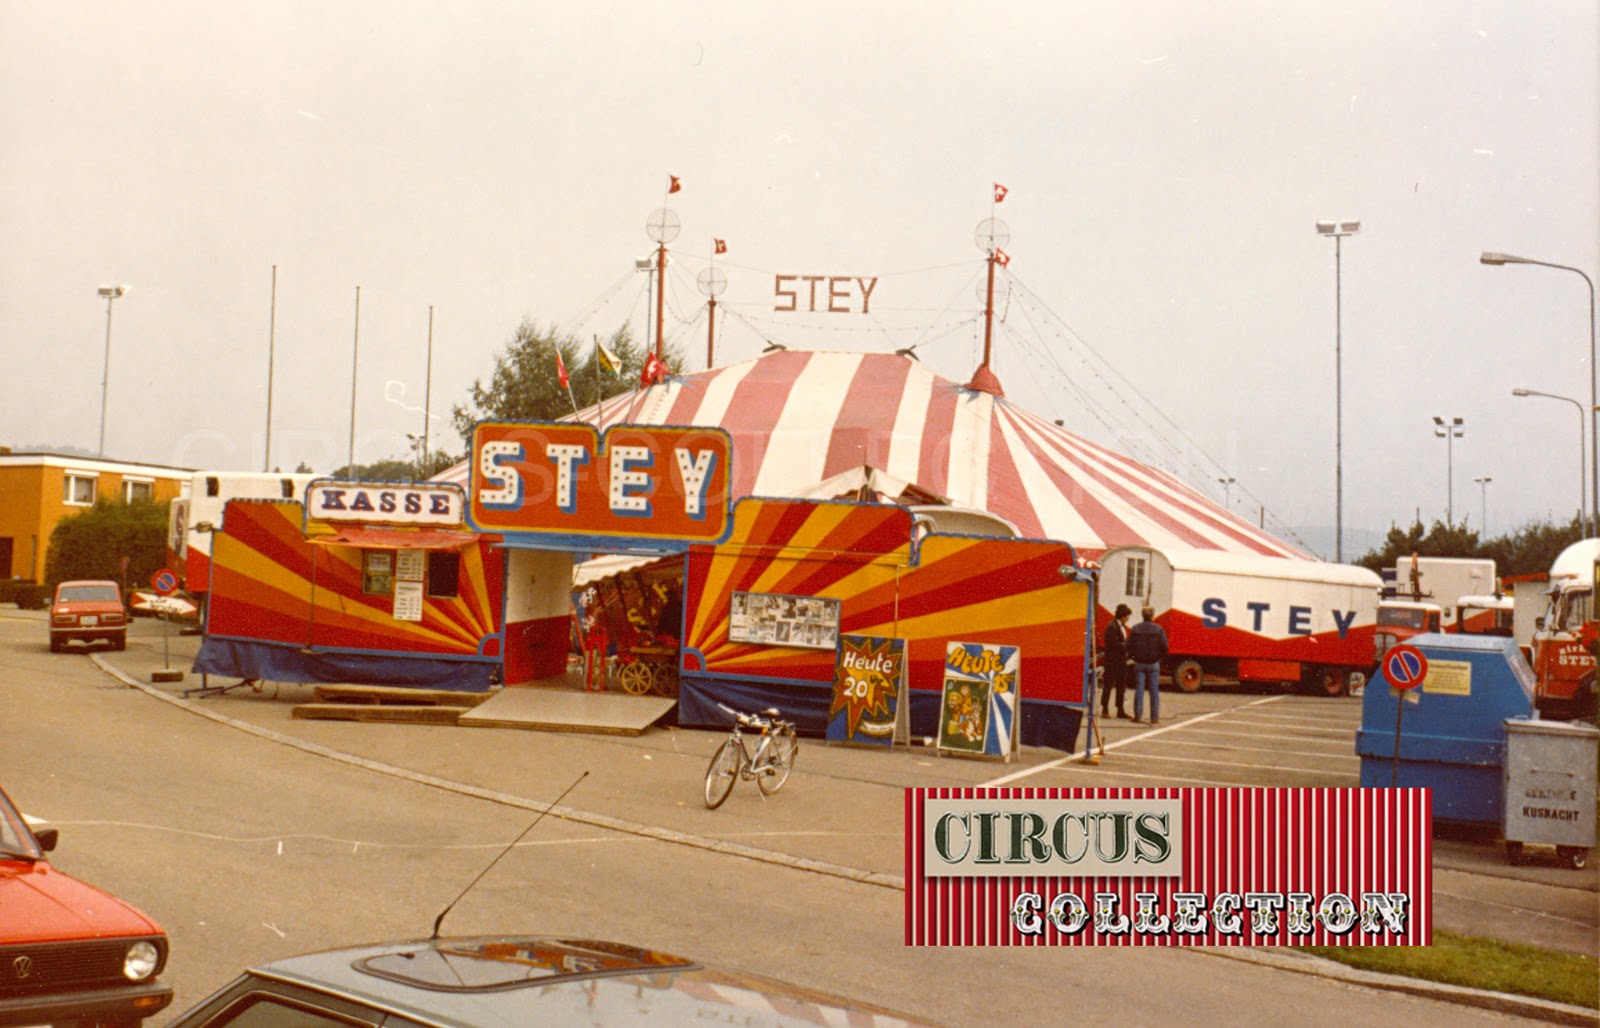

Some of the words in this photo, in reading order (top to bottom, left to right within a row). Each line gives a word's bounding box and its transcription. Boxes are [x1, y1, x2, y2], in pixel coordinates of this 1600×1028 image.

[774, 274, 878, 314] STEY
[480, 440, 716, 518] STEY
[321, 490, 450, 515] KASSE
[1202, 598, 1357, 639] STEY
[843, 651, 893, 674] Heute
[843, 676, 868, 698] 20
